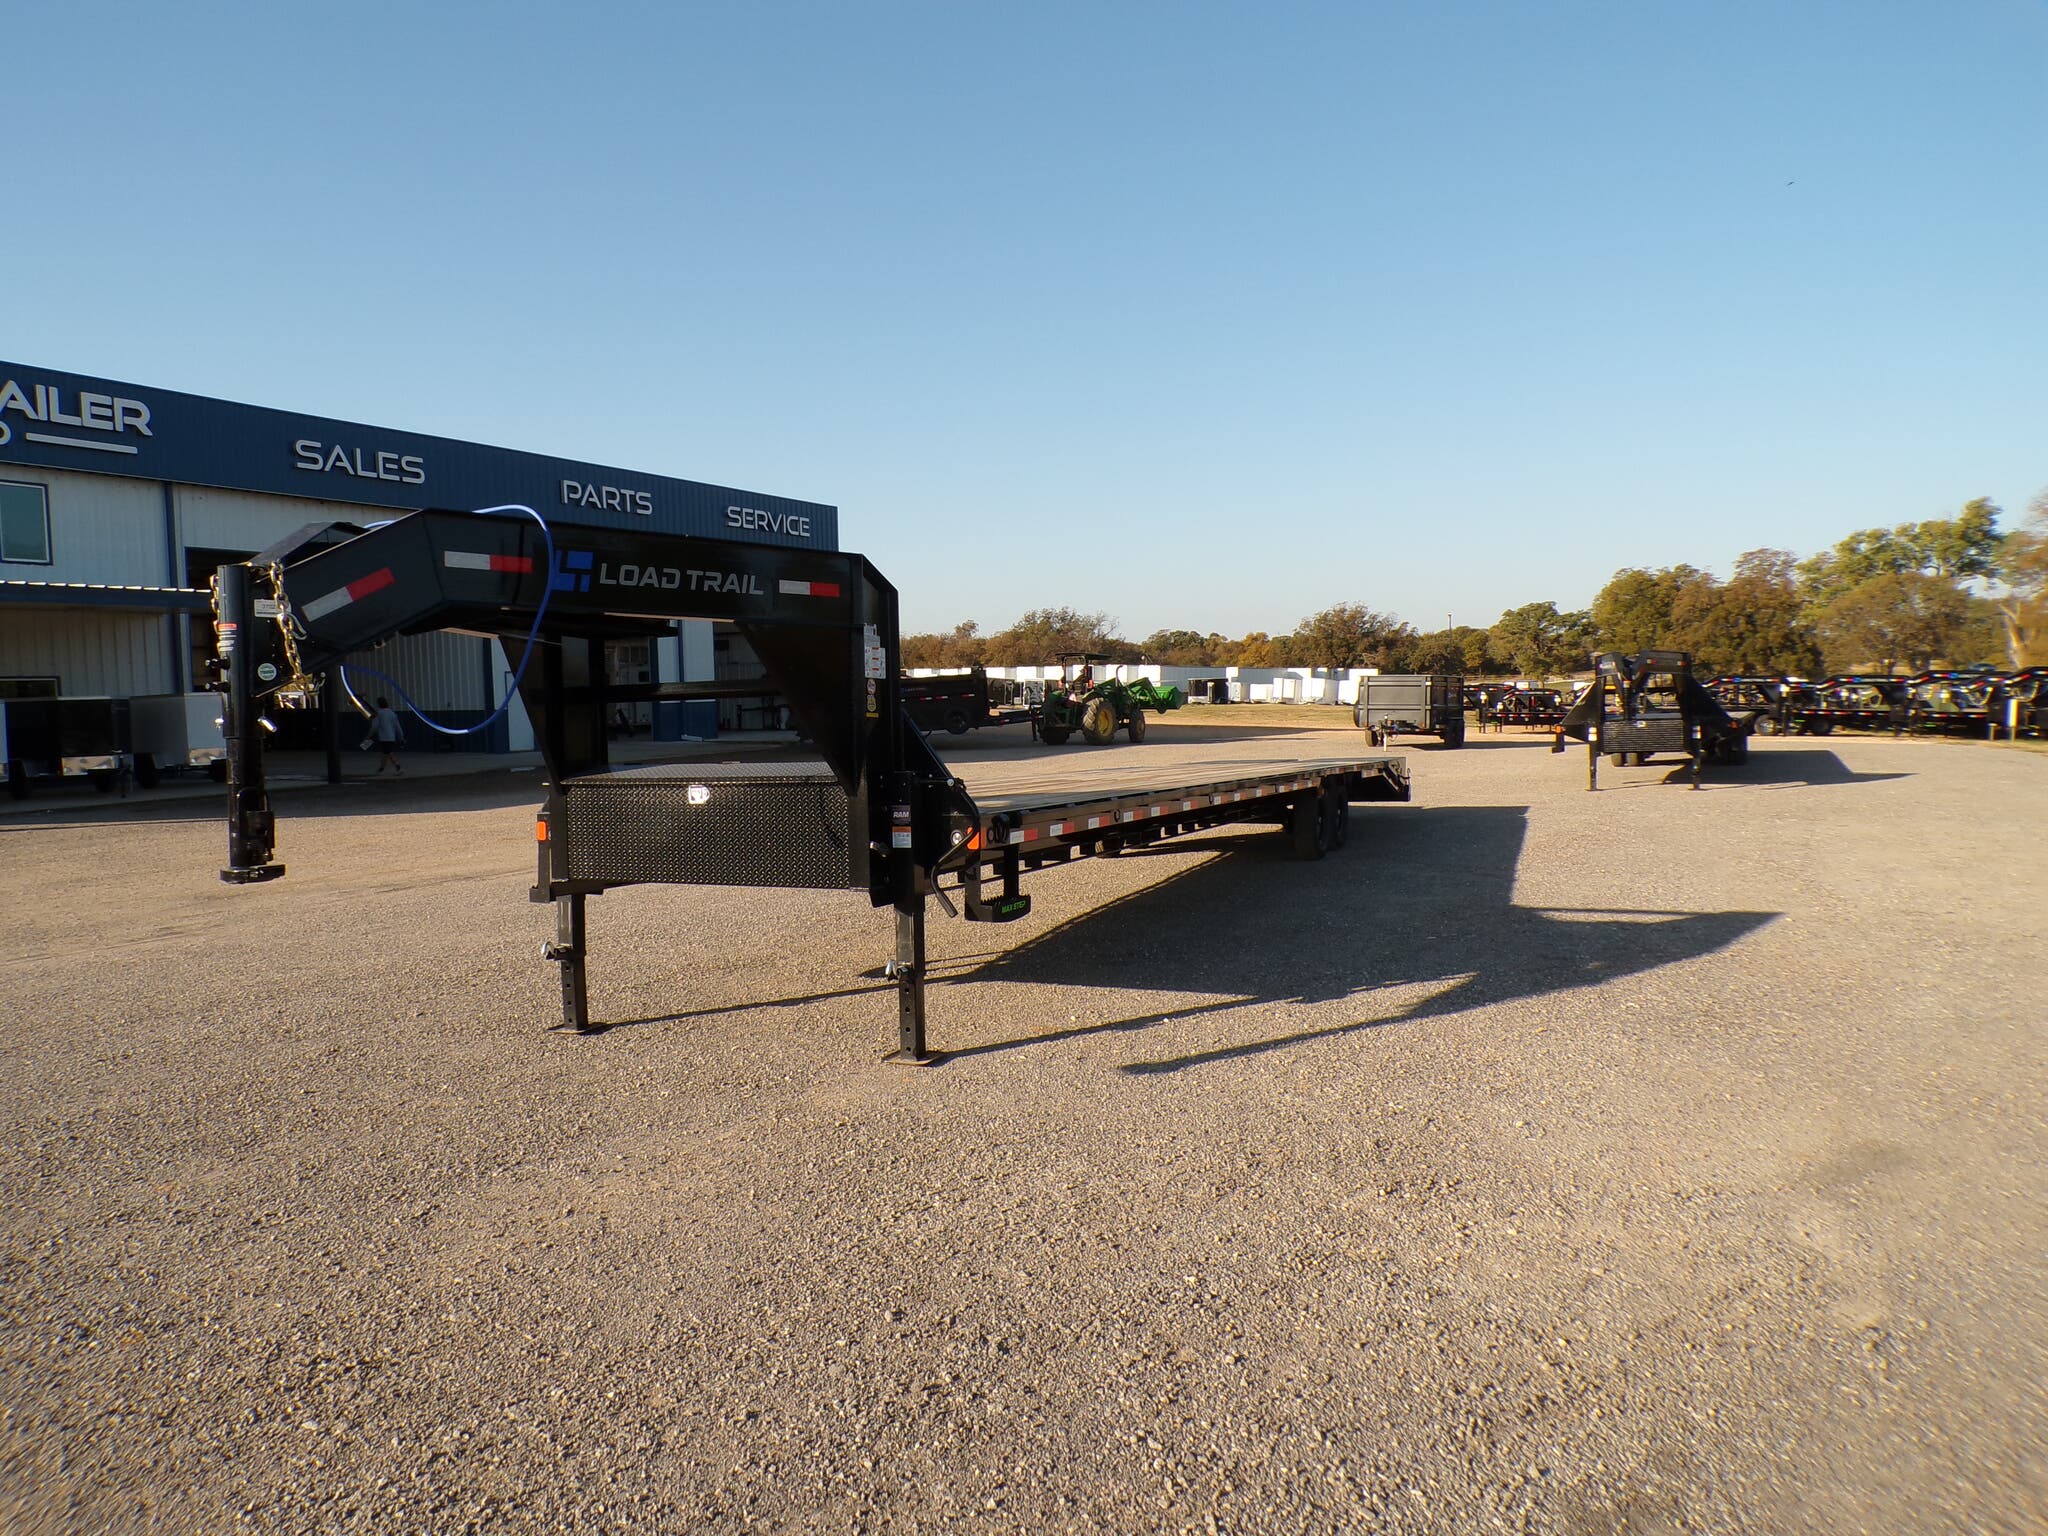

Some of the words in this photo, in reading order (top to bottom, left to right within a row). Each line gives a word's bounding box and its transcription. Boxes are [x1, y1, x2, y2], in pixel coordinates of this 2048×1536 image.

[295, 439, 426, 484] SALES
[561, 479, 653, 515] PARTS
[727, 506, 810, 537] SERVICE
[601, 564, 680, 590] LOAD
[687, 569, 765, 596] TRAIL
